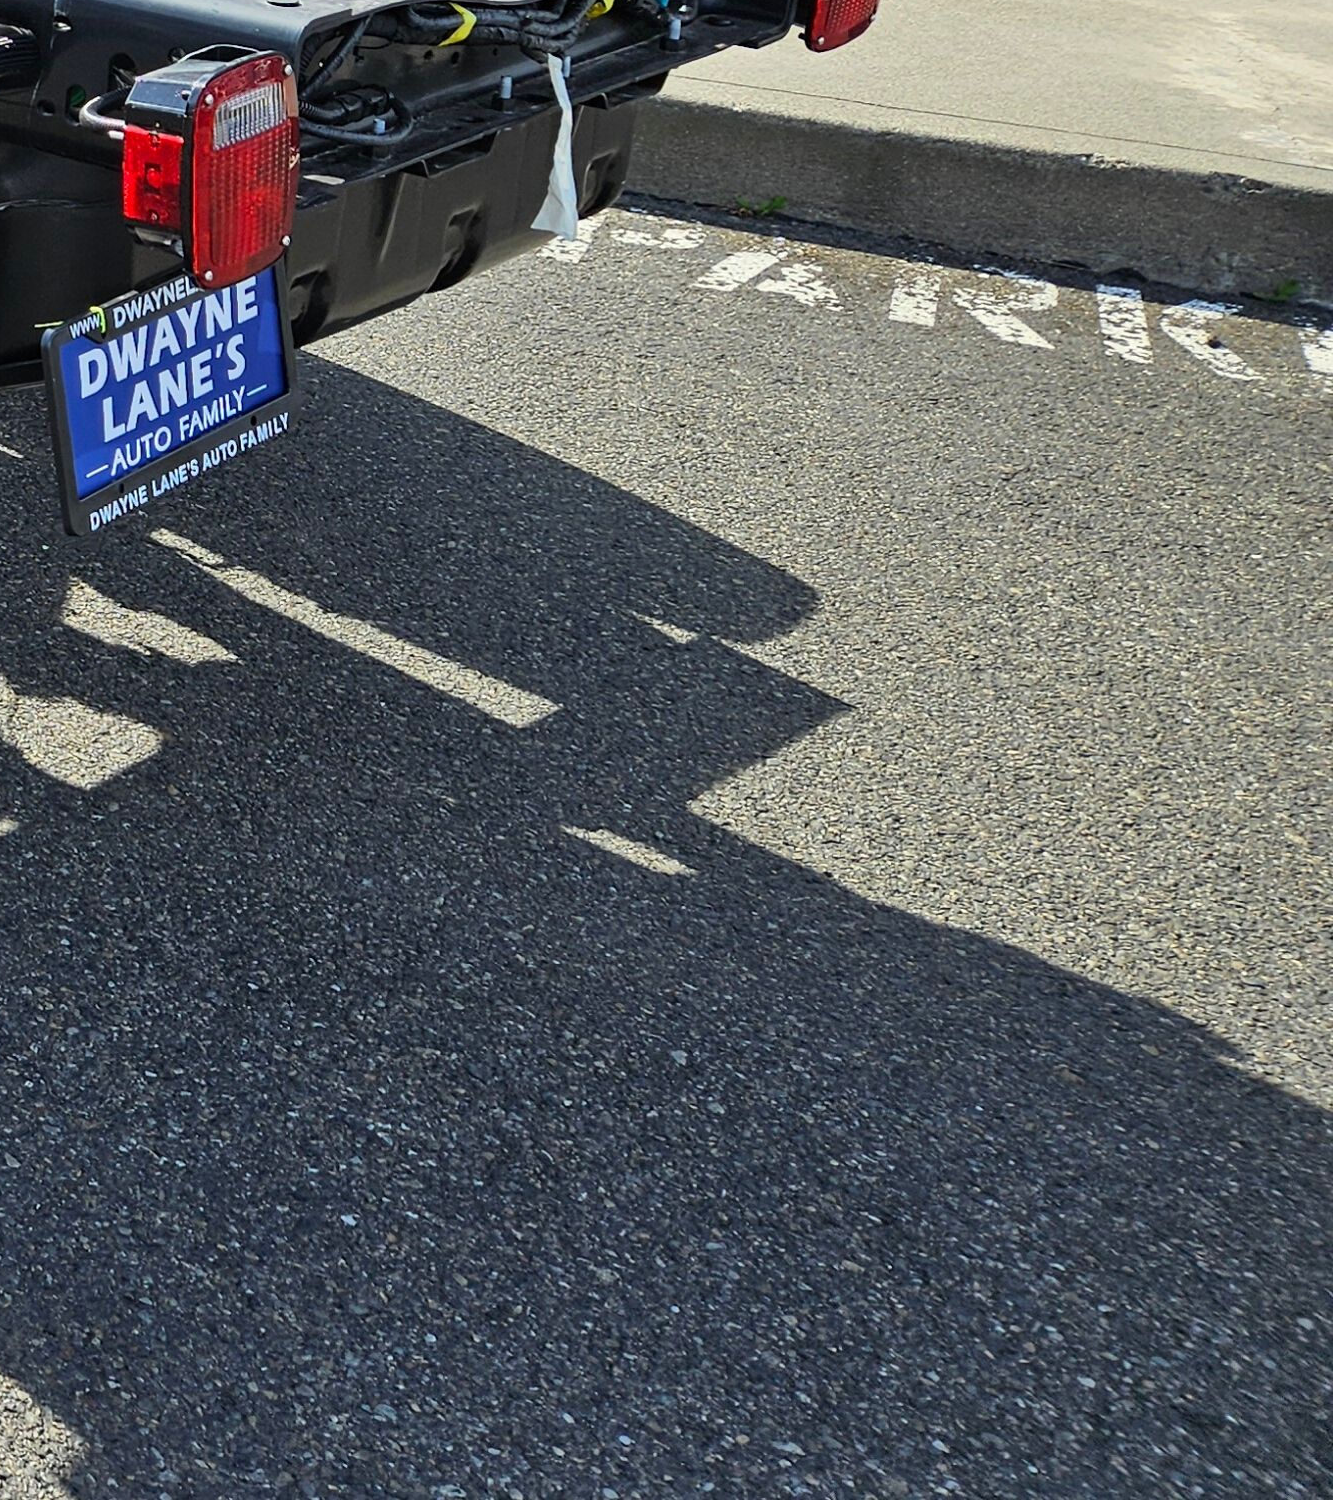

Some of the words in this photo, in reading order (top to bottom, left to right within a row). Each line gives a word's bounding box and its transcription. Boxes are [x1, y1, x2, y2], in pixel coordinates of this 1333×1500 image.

[78, 275, 259, 399] DWAYNE
[102, 334, 246, 443] LANE'S
[89, 485, 149, 531] DWAYNE
[151, 454, 200, 498] LANE'S
[201, 440, 238, 473] AUTO
[239, 412, 289, 454] FAMILY
[110, 427, 172, 476] AUTO
[180, 386, 246, 441] FAMILY
